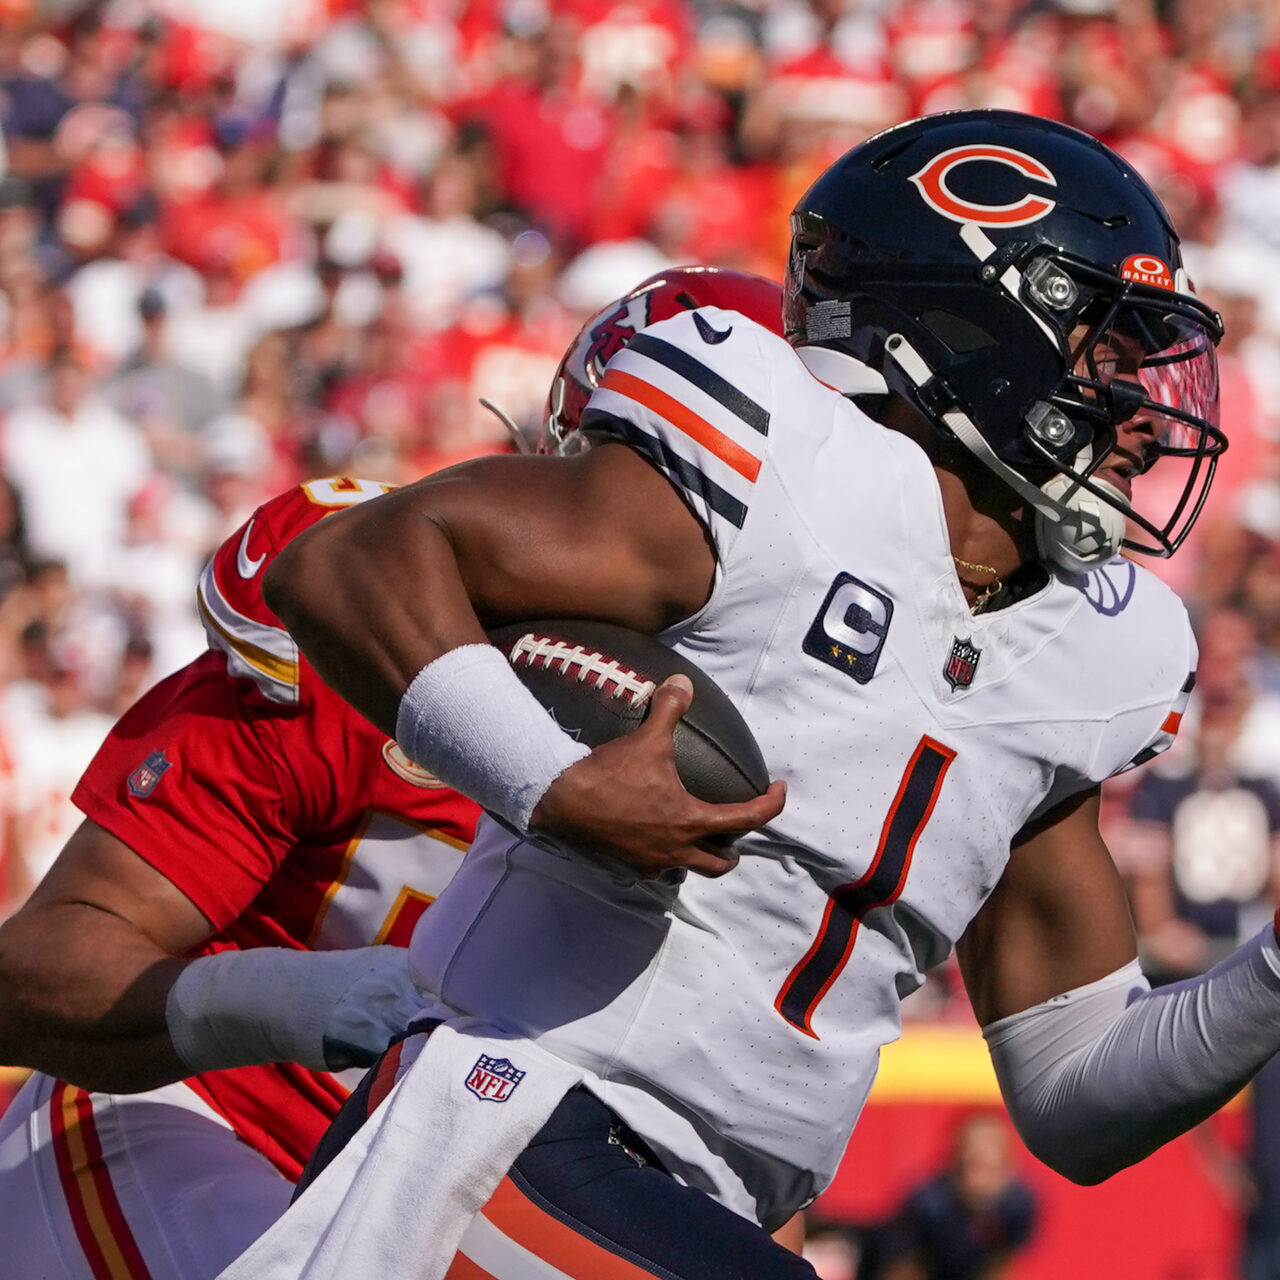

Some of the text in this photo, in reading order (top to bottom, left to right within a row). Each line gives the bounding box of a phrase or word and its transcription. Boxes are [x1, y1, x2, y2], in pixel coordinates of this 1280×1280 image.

[1123, 270, 1171, 287] OAKLEY
[822, 582, 887, 655] C
[773, 733, 958, 1041] 1
[467, 1067, 511, 1101] NFL
